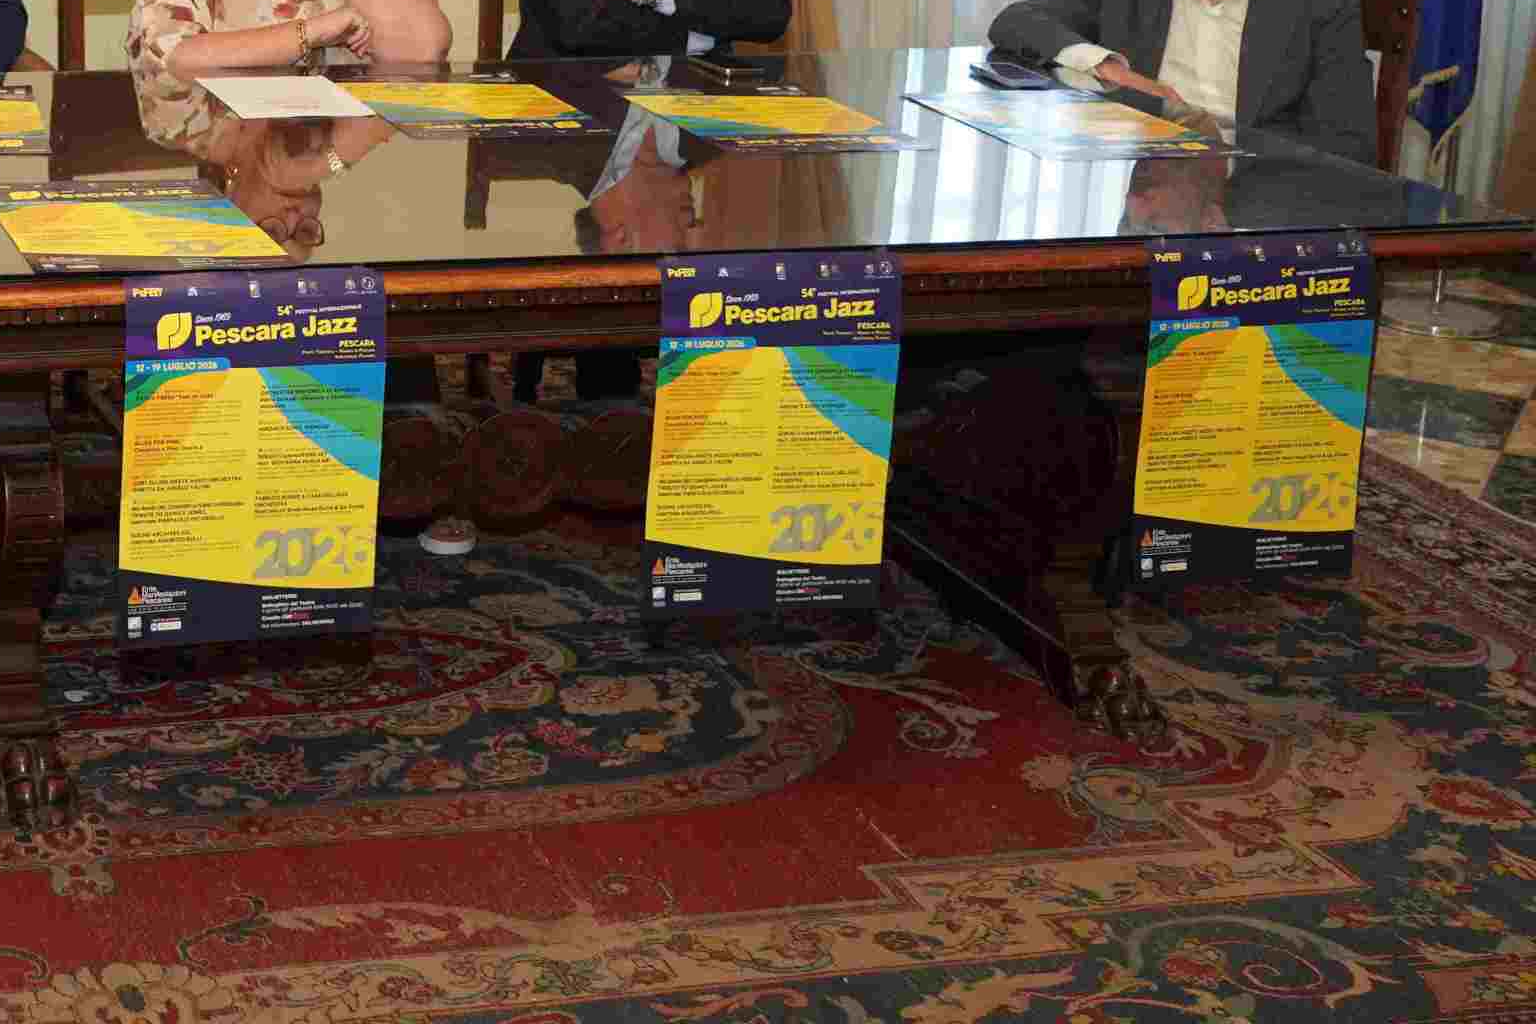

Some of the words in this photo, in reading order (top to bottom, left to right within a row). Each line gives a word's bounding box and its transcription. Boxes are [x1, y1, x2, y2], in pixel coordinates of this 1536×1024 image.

[1210, 283, 1297, 307] Pescara
[1303, 277, 1351, 297] Jazz
[724, 303, 818, 326] Pescara
[823, 298, 876, 319] Jazz
[194, 322, 296, 347] Pescara
[302, 315, 358, 337] Jazz
